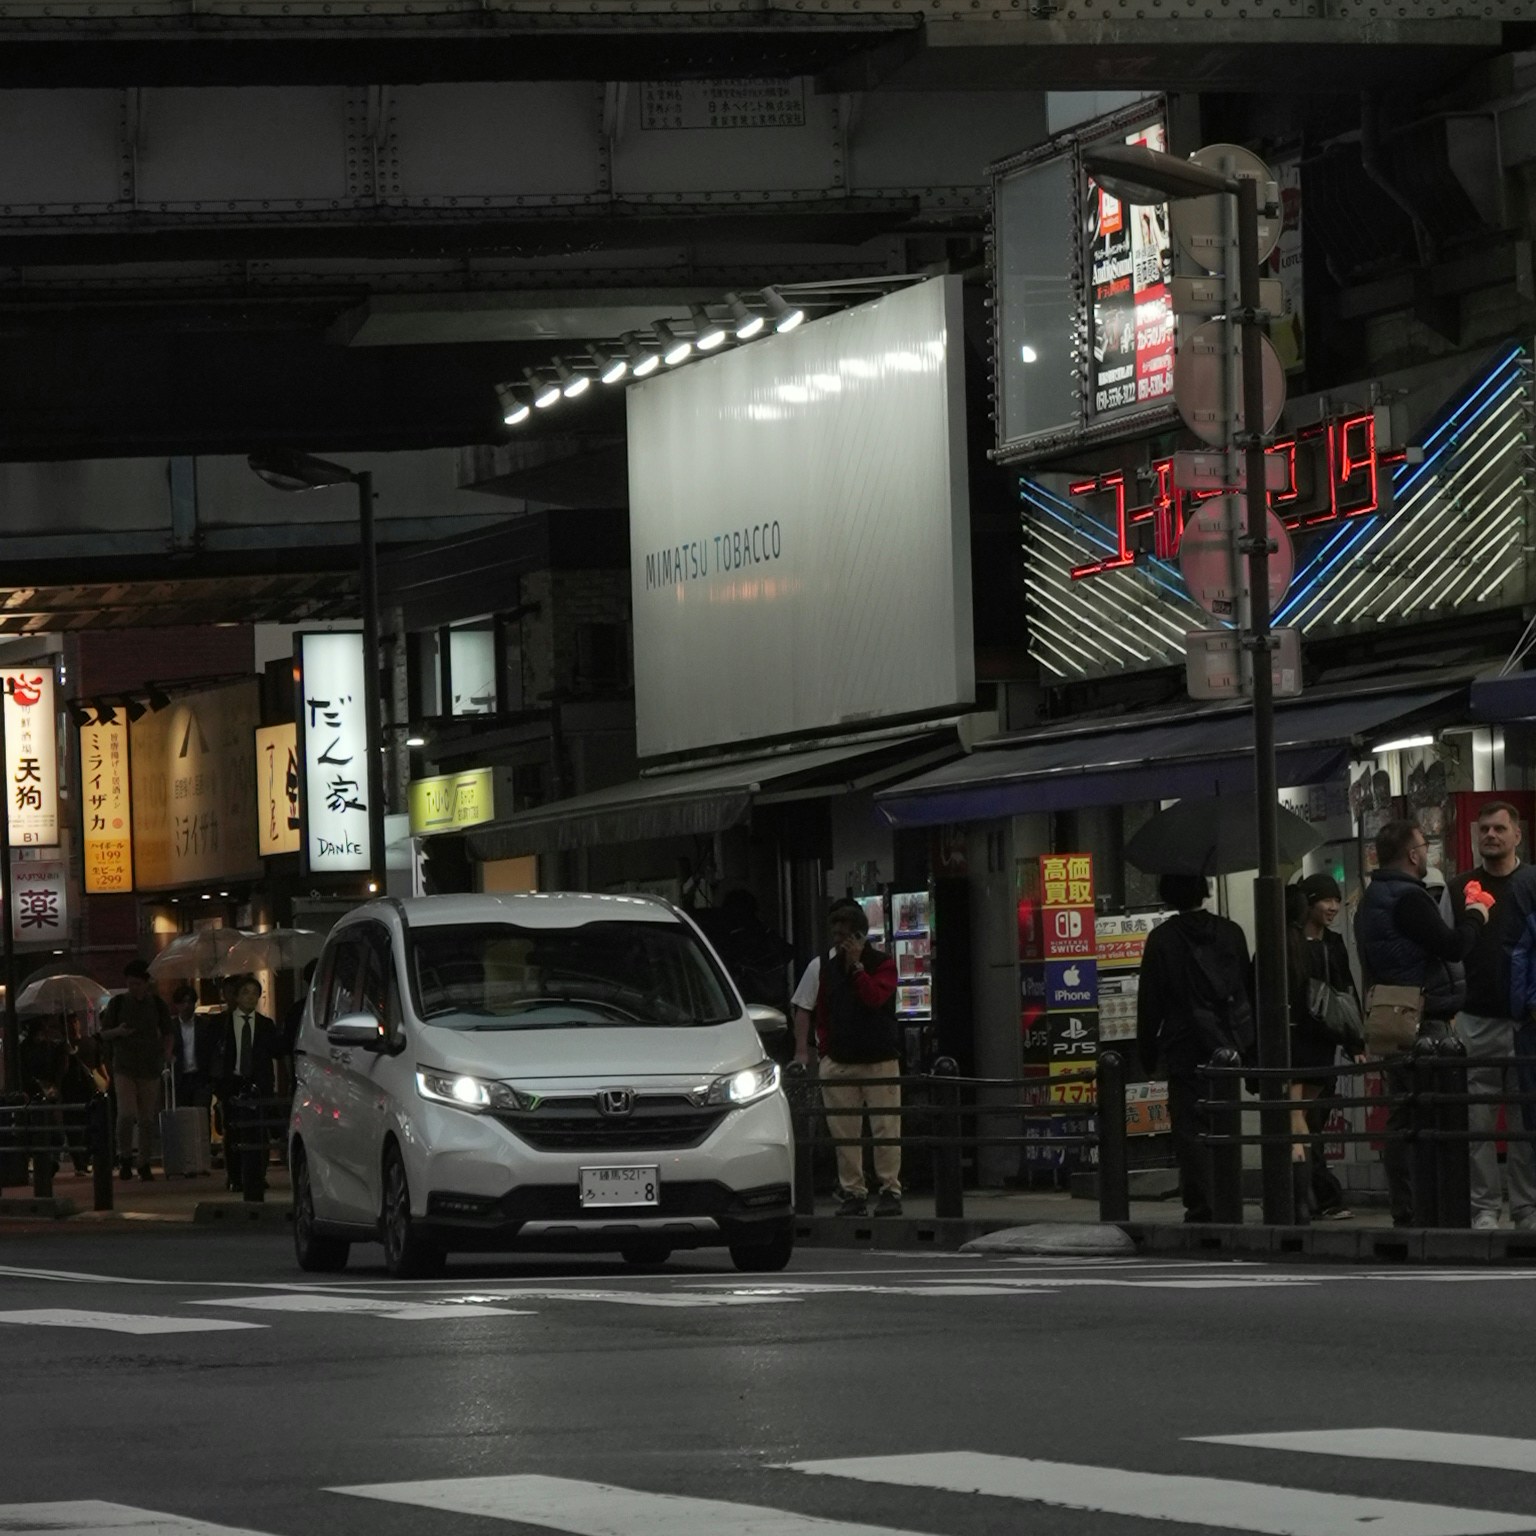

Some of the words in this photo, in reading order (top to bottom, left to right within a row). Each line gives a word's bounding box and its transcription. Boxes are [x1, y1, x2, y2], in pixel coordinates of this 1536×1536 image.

[645, 538, 708, 591] MIMATSU
[713, 520, 781, 574] TOBACCO
[14, 757, 42, 811] 天狗
[88, 733, 107, 832] ミライザカ
[23, 832, 40, 843] B1
[1043, 857, 1091, 880] 高価
[1044, 880, 1092, 904] 買取
[20, 889, 60, 930] 薬
[1051, 943, 1089, 954] SWITCH
[1054, 989, 1092, 1002] iPhone
[1053, 1041, 1097, 1056] PS5
